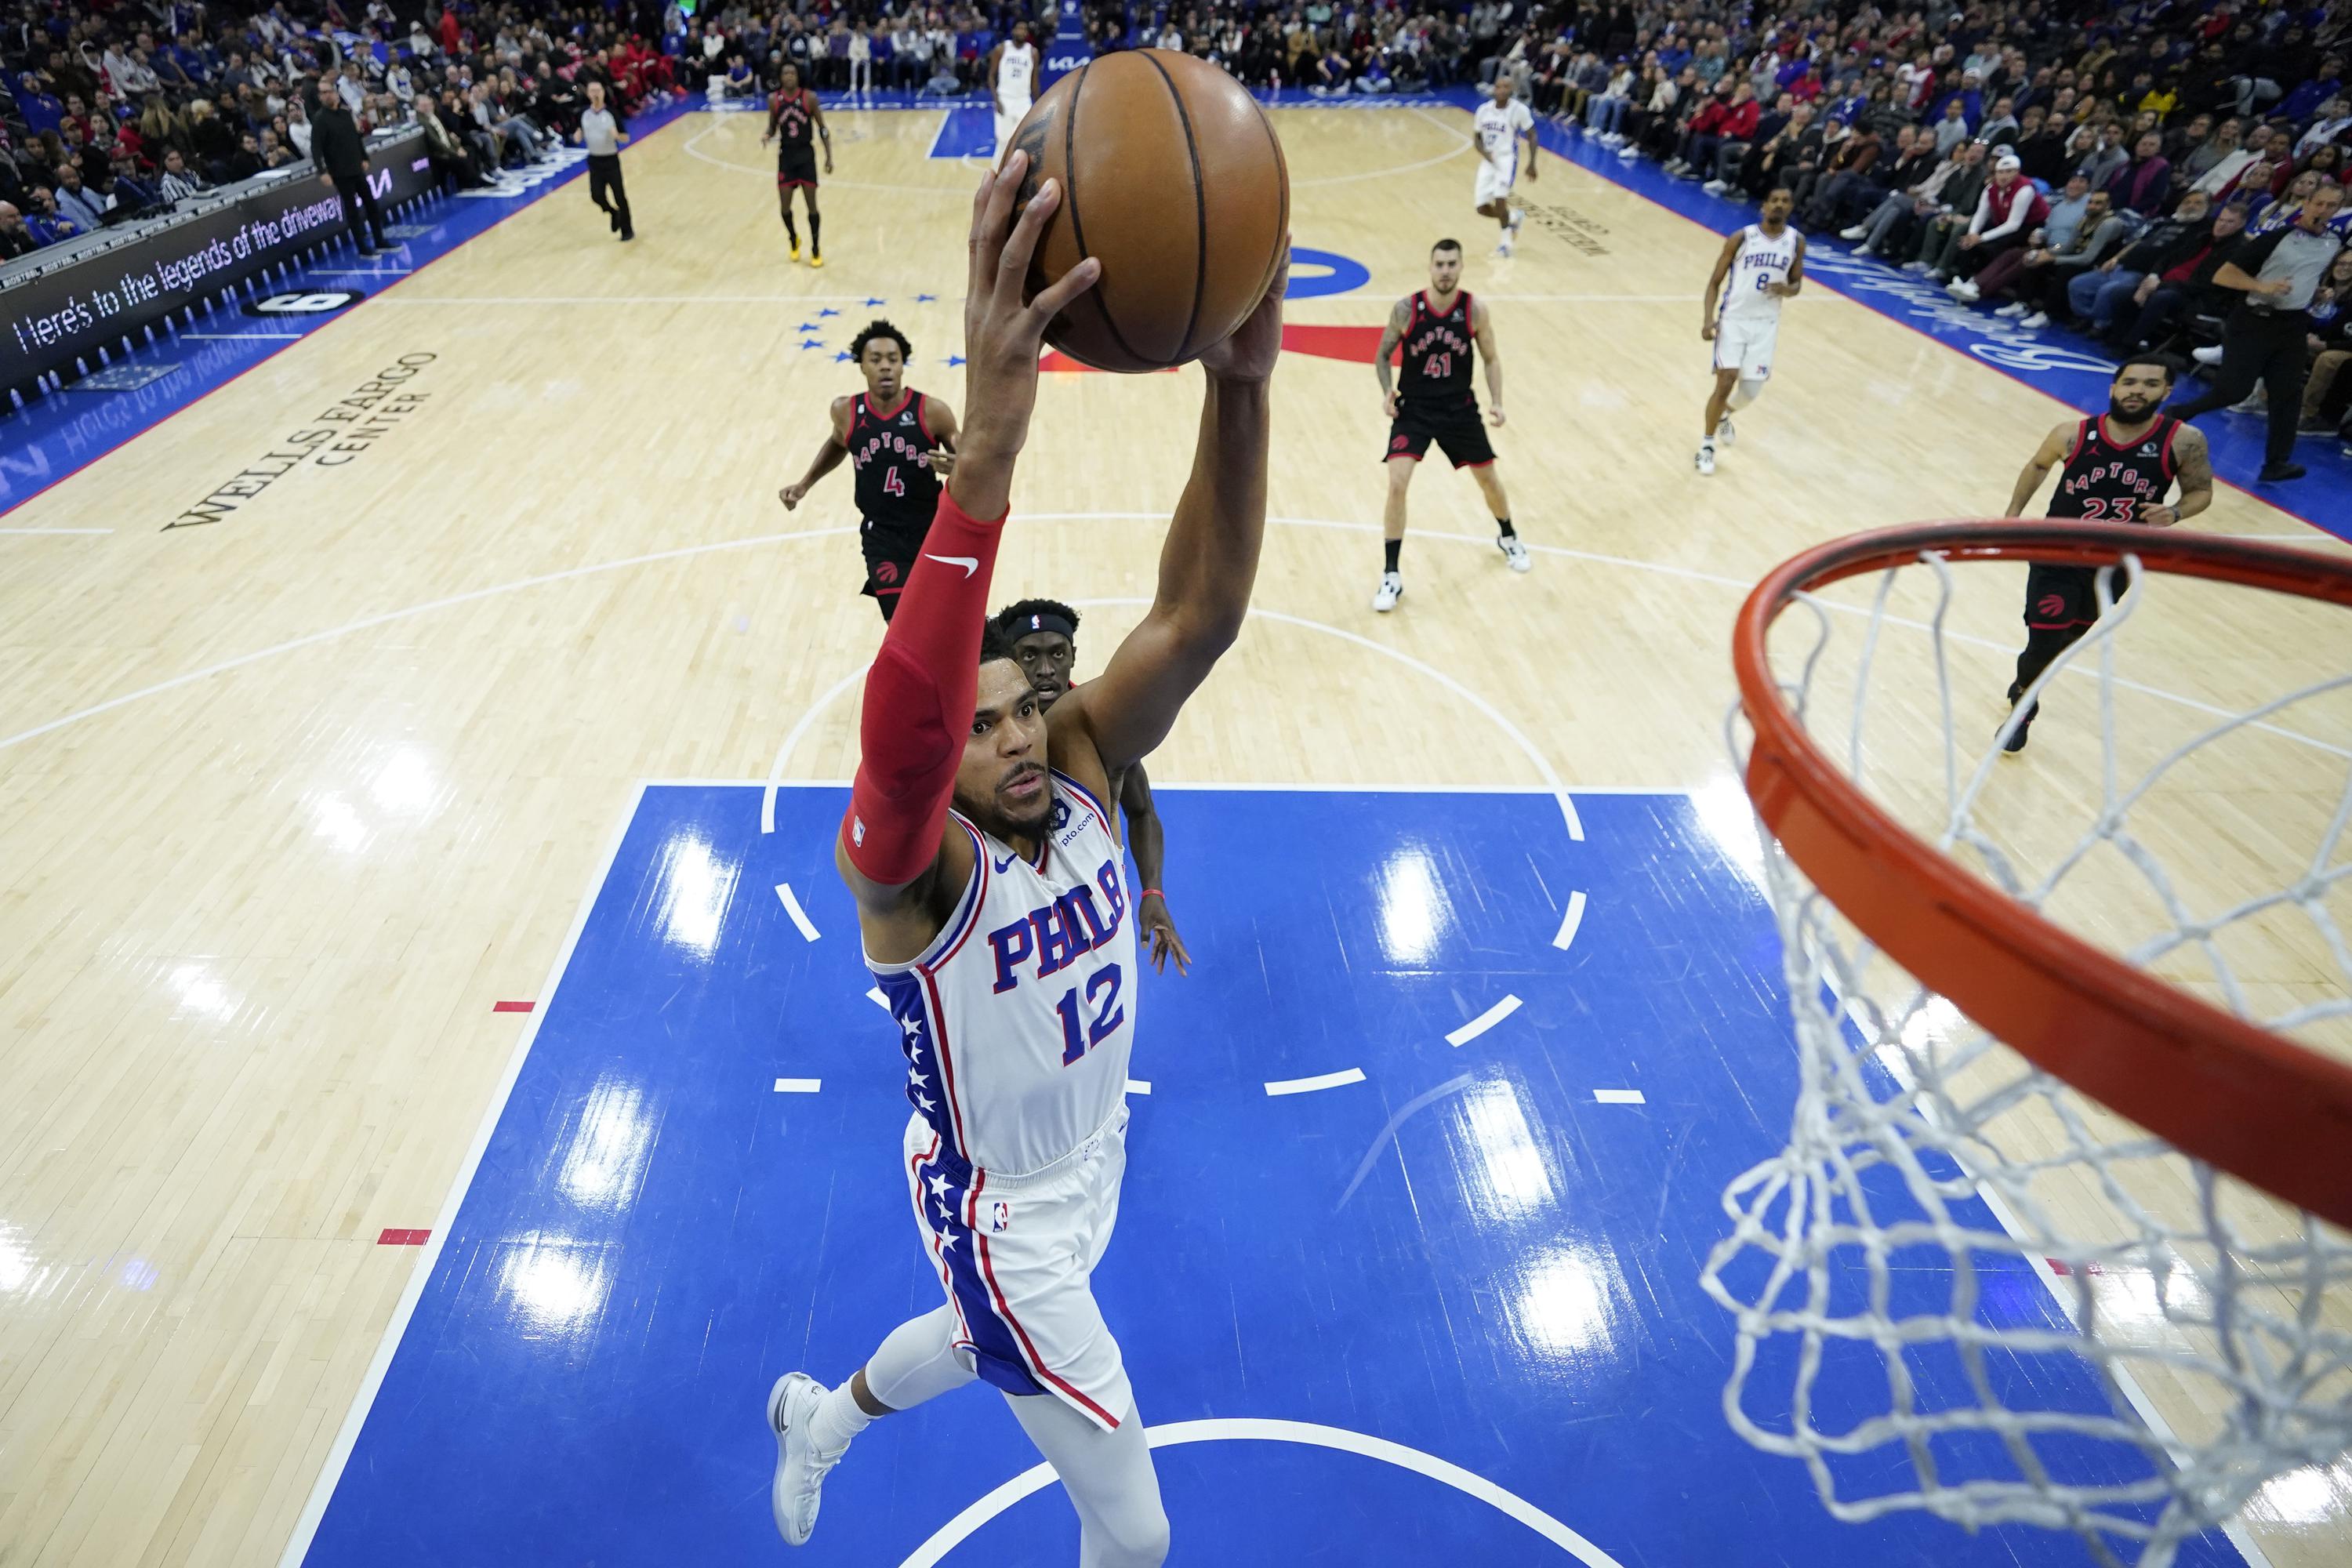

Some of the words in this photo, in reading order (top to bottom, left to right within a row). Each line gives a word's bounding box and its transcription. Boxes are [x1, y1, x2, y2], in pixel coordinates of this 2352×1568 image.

[12, 295, 93, 354] Here's
[92, 289, 120, 318] to
[120, 273, 158, 307] the
[155, 238, 232, 292] legends
[233, 224, 252, 260] of
[251, 220, 281, 250] the
[280, 194, 344, 238] driveway
[1755, 273, 1769, 291] 8
[1410, 326, 1468, 356] RAPTORS
[1423, 352, 1452, 379] 41
[159, 430, 337, 532] WELLS
[313, 352, 438, 423] FARGO
[314, 392, 432, 466] CENTER
[853, 431, 928, 470] RAPTORS
[883, 466, 906, 497] 4
[2065, 462, 2158, 500] RAPTORS
[2080, 497, 2136, 524] 23
[1060, 813, 1095, 848] pto.com
[1056, 962, 1124, 1067] 12
